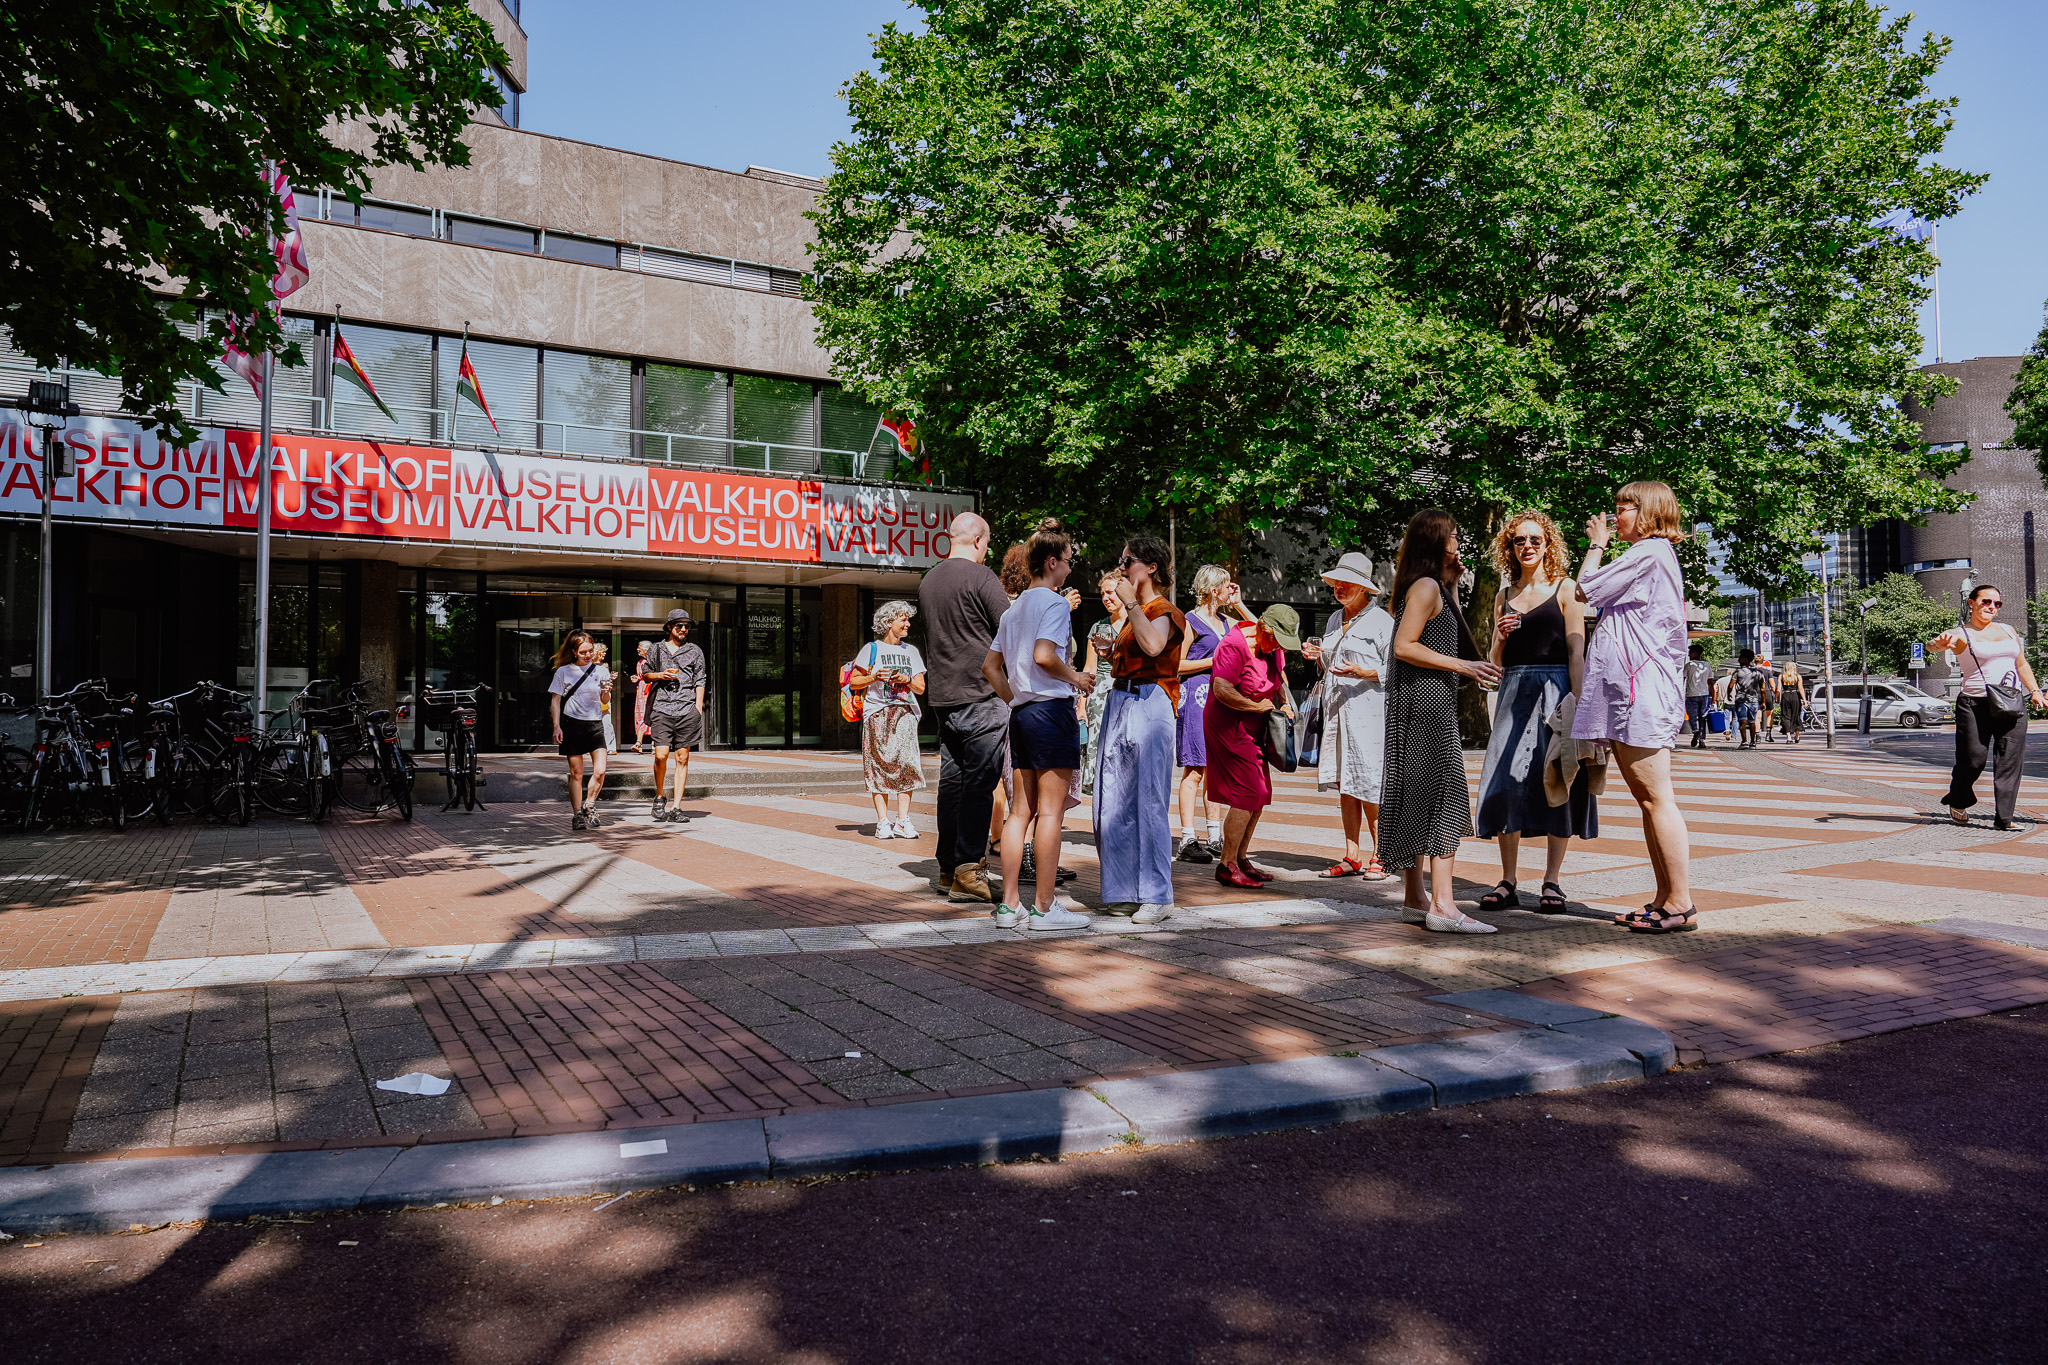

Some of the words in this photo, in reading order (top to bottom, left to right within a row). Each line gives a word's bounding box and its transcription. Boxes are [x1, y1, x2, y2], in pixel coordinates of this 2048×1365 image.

[0, 461, 221, 510] ALKHOF
[227, 478, 444, 527] MUSEUM
[454, 496, 645, 538] VALKHOF
[650, 511, 817, 551] MUSEUM
[824, 523, 951, 559] VALKHO
[228, 442, 449, 492] VALKHOF
[455, 462, 643, 507] MUSEUM
[650, 478, 819, 520] VALKHOF
